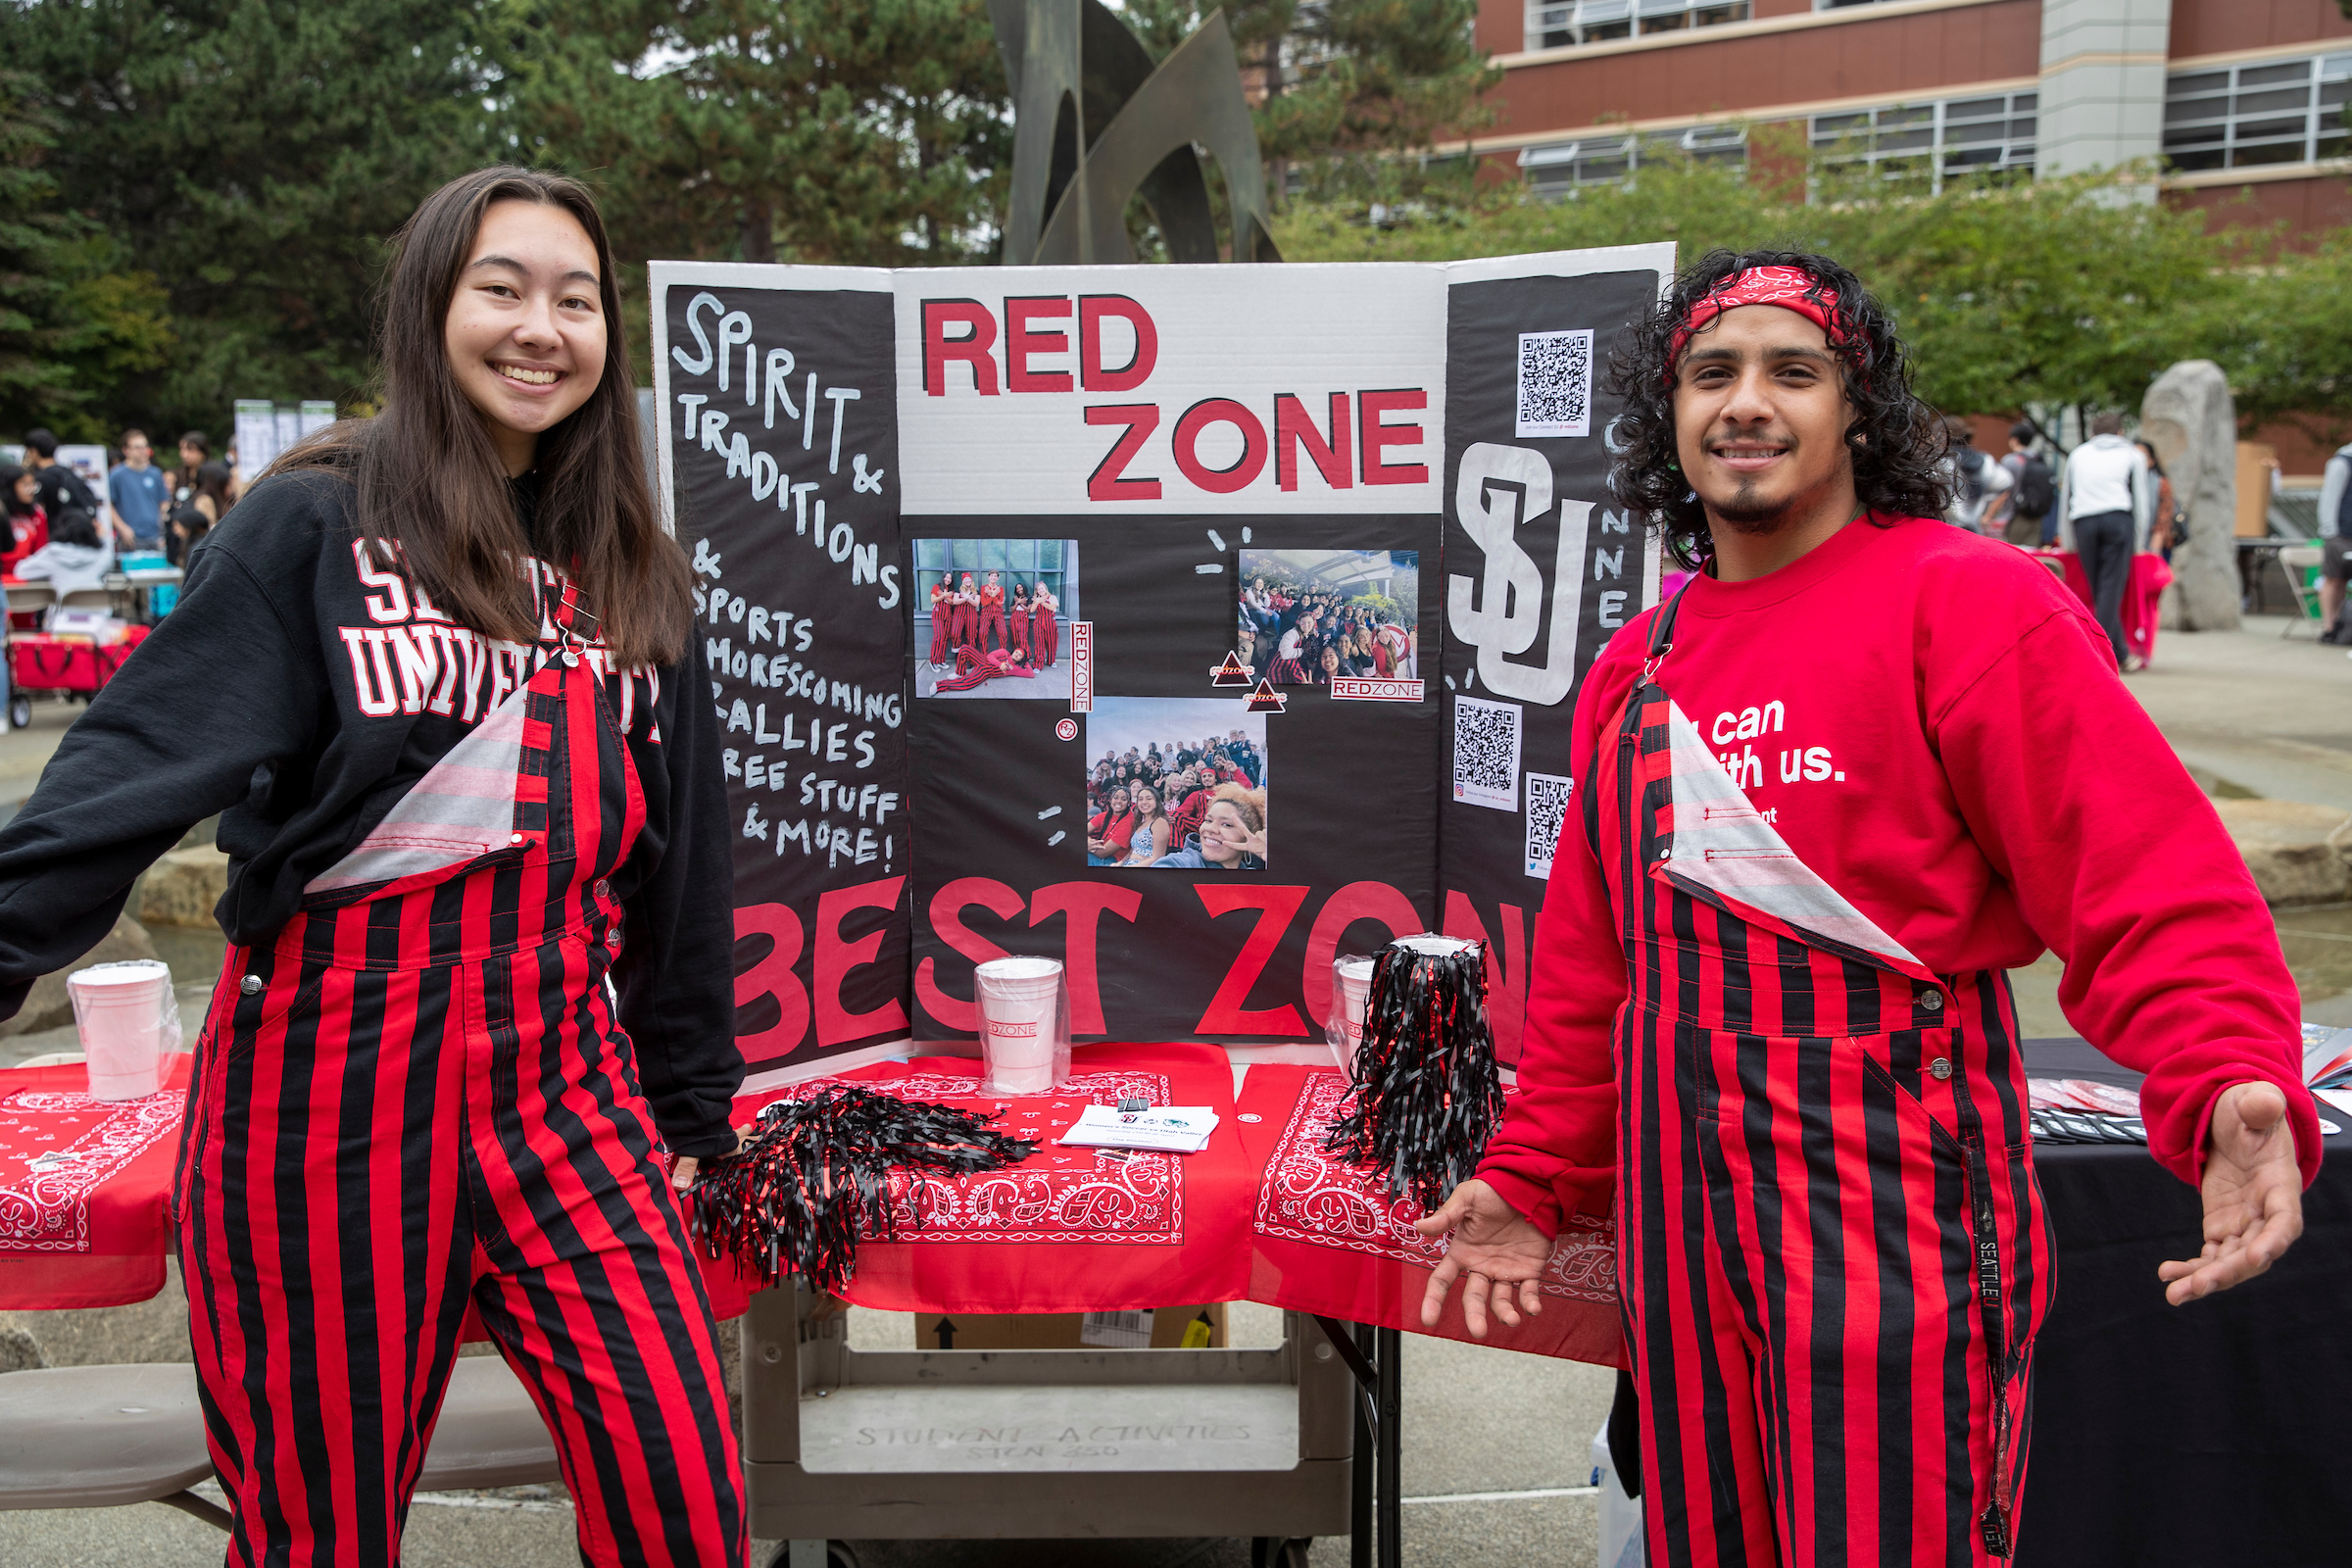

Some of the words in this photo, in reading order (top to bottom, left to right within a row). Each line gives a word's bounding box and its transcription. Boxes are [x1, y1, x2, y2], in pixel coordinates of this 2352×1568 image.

[920, 293, 1158, 396] RED
[672, 291, 861, 474] SPIRIT
[853, 453, 884, 495] &
[1084, 388, 1429, 502] ZONE
[677, 394, 900, 610] TRADITIONS
[692, 537, 721, 578] &
[691, 580, 813, 652] SPORTS
[1075, 624, 1088, 710] REDZONE
[1334, 682, 1422, 697] REDZONE
[1712, 700, 1786, 745] can
[722, 748, 788, 791] REE
[800, 772, 899, 825] STUFF
[1780, 746, 1846, 784] us.
[743, 802, 768, 841] &
[776, 818, 893, 873] MORE!
[733, 874, 1143, 1064] BEST
[1193, 881, 1543, 1068] ZON
[856, 1427, 1022, 1446] STUDENT
[1058, 1425, 1251, 1443] ACTIVITIES
